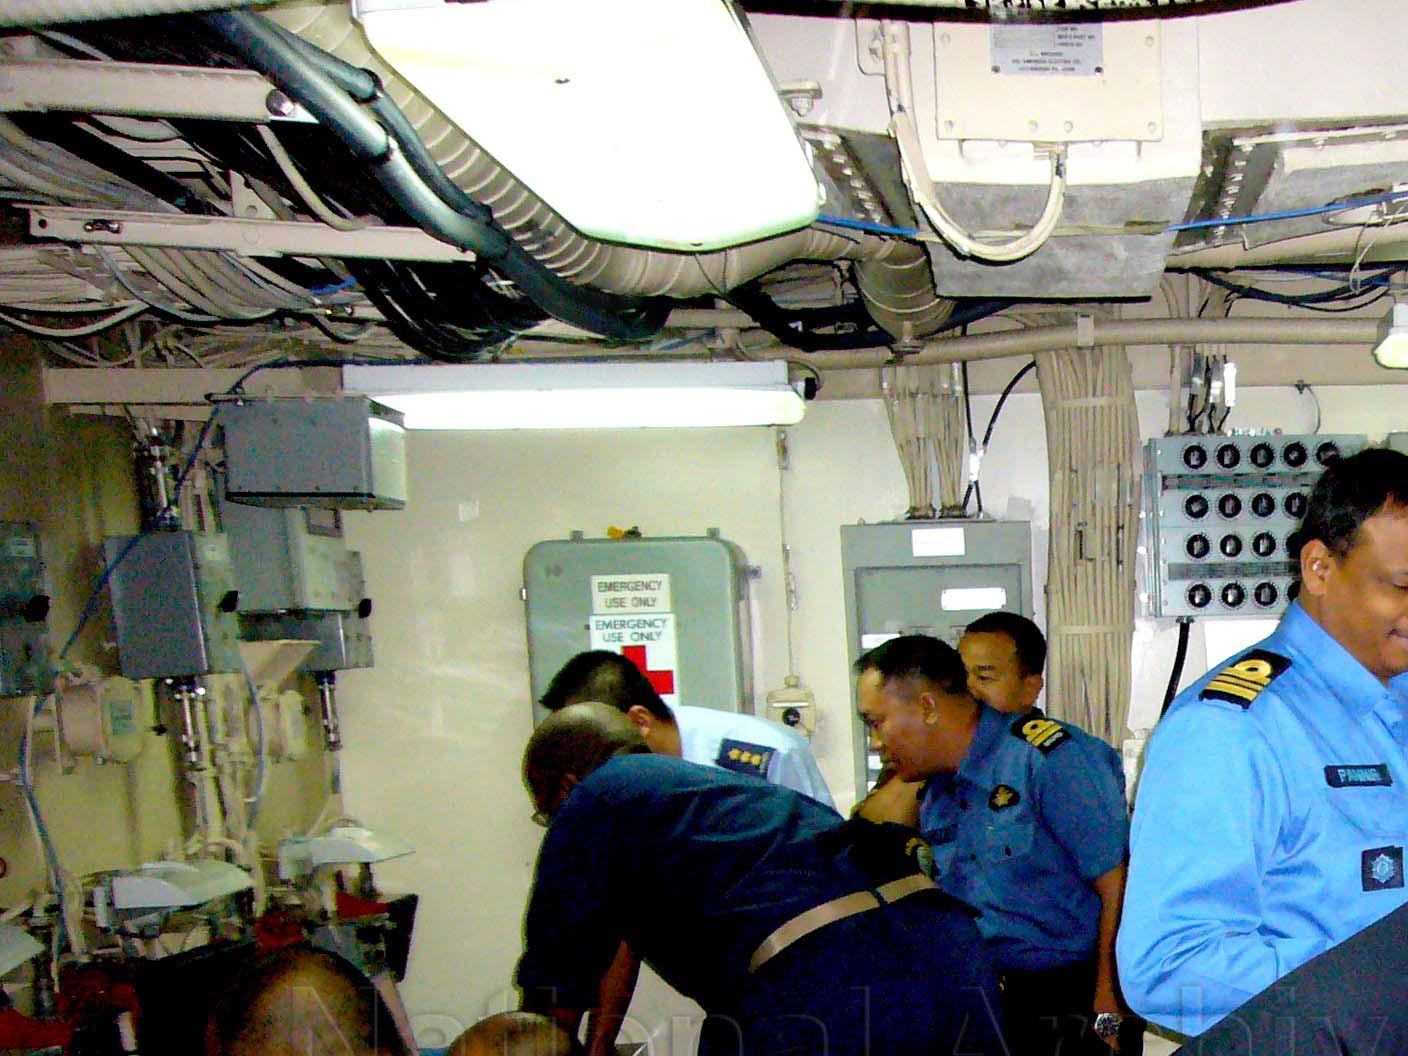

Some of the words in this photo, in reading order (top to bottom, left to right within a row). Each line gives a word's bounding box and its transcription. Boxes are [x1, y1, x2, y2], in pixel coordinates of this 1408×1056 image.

[598, 581, 662, 592] EMERGENCY
[605, 598, 627, 608] USE
[632, 597, 657, 607] ONLY
[596, 619, 667, 630] EMERGENCY
[603, 633, 624, 642] USE
[630, 632, 662, 641] ONLY
